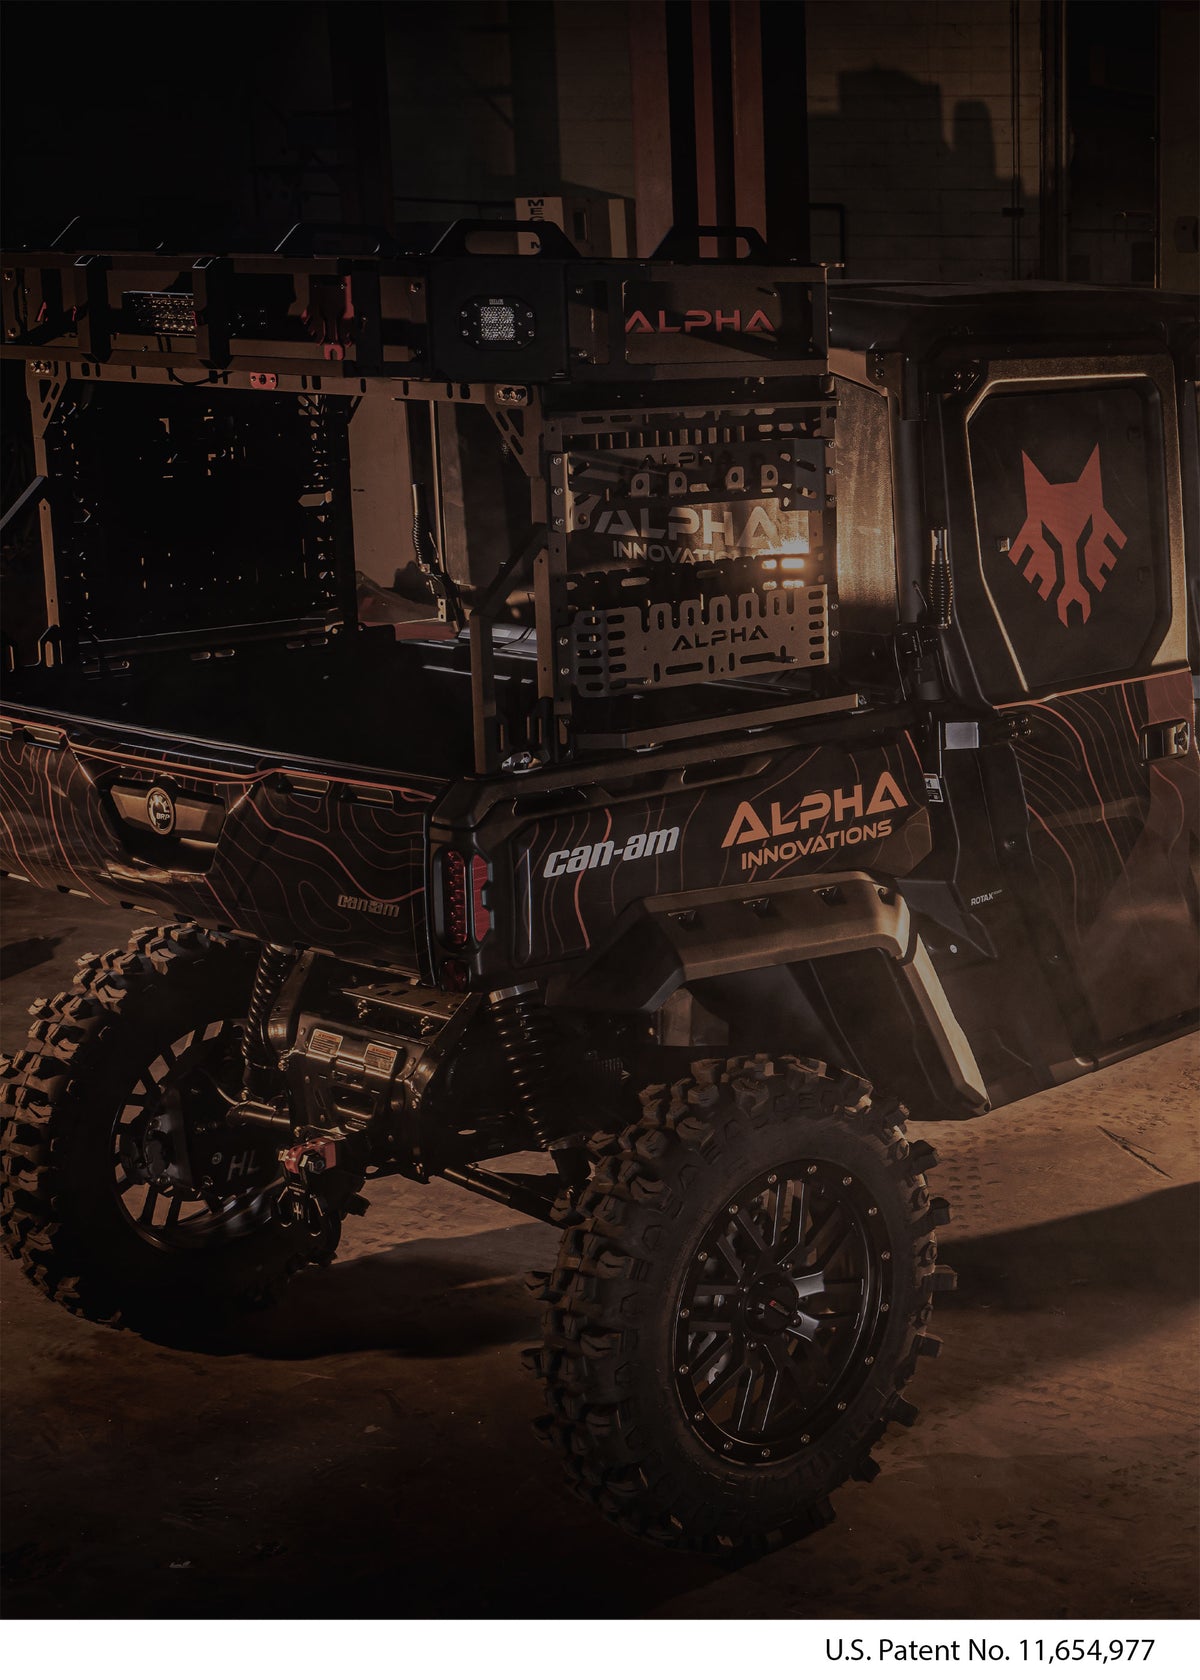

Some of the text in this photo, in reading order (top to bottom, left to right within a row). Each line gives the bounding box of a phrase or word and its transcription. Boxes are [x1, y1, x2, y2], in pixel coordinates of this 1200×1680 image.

[624, 309, 776, 334] ALPHA
[594, 505, 780, 548] ALPHA
[672, 624, 769, 652] ALPHA
[720, 771, 908, 849] ALPHA
[542, 826, 680, 879] can-am
[741, 819, 893, 871] INNOVATIONS
[970, 891, 994, 906] ROTAX
